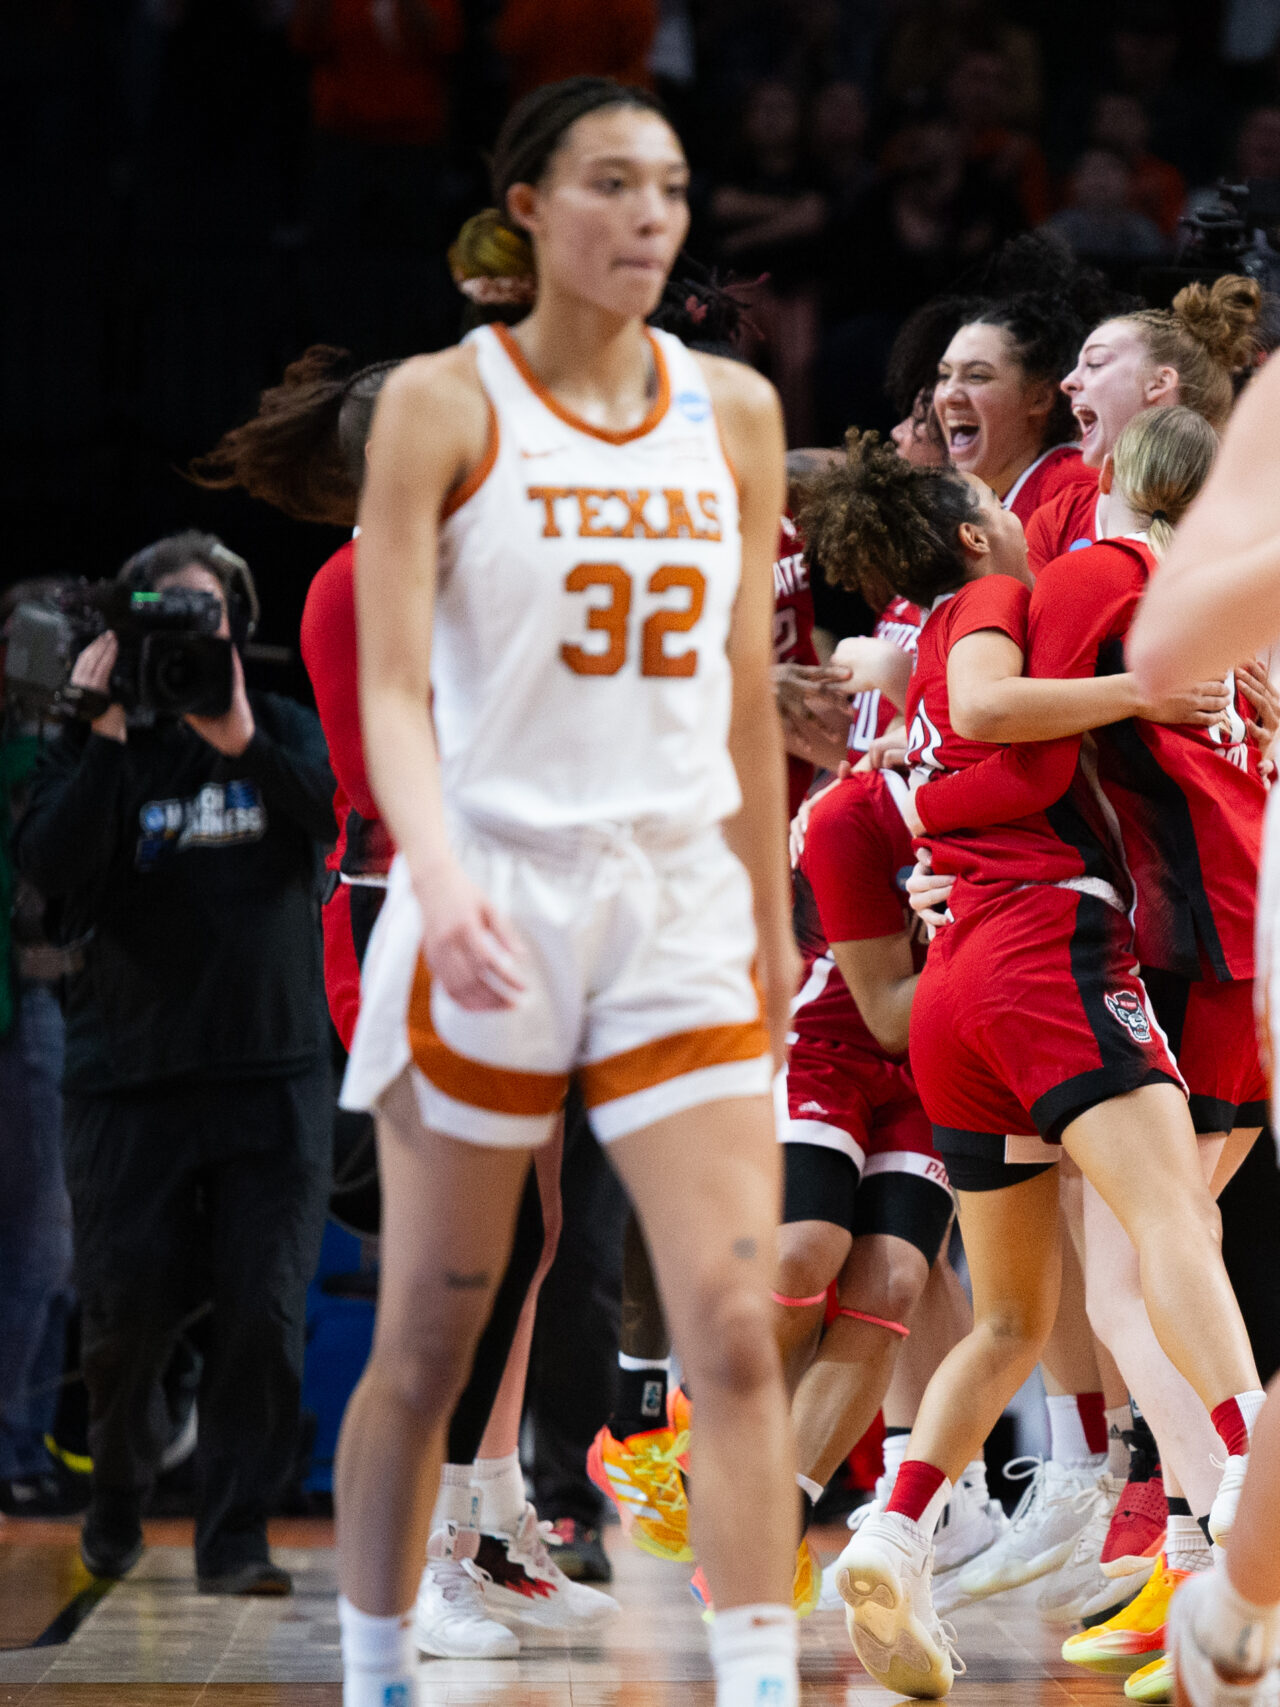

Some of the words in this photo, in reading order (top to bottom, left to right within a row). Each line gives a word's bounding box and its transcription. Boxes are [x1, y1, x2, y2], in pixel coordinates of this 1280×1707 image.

[527, 486, 722, 542] TEXAS
[558, 562, 707, 678] 32
[924, 1161, 953, 1191] PA
